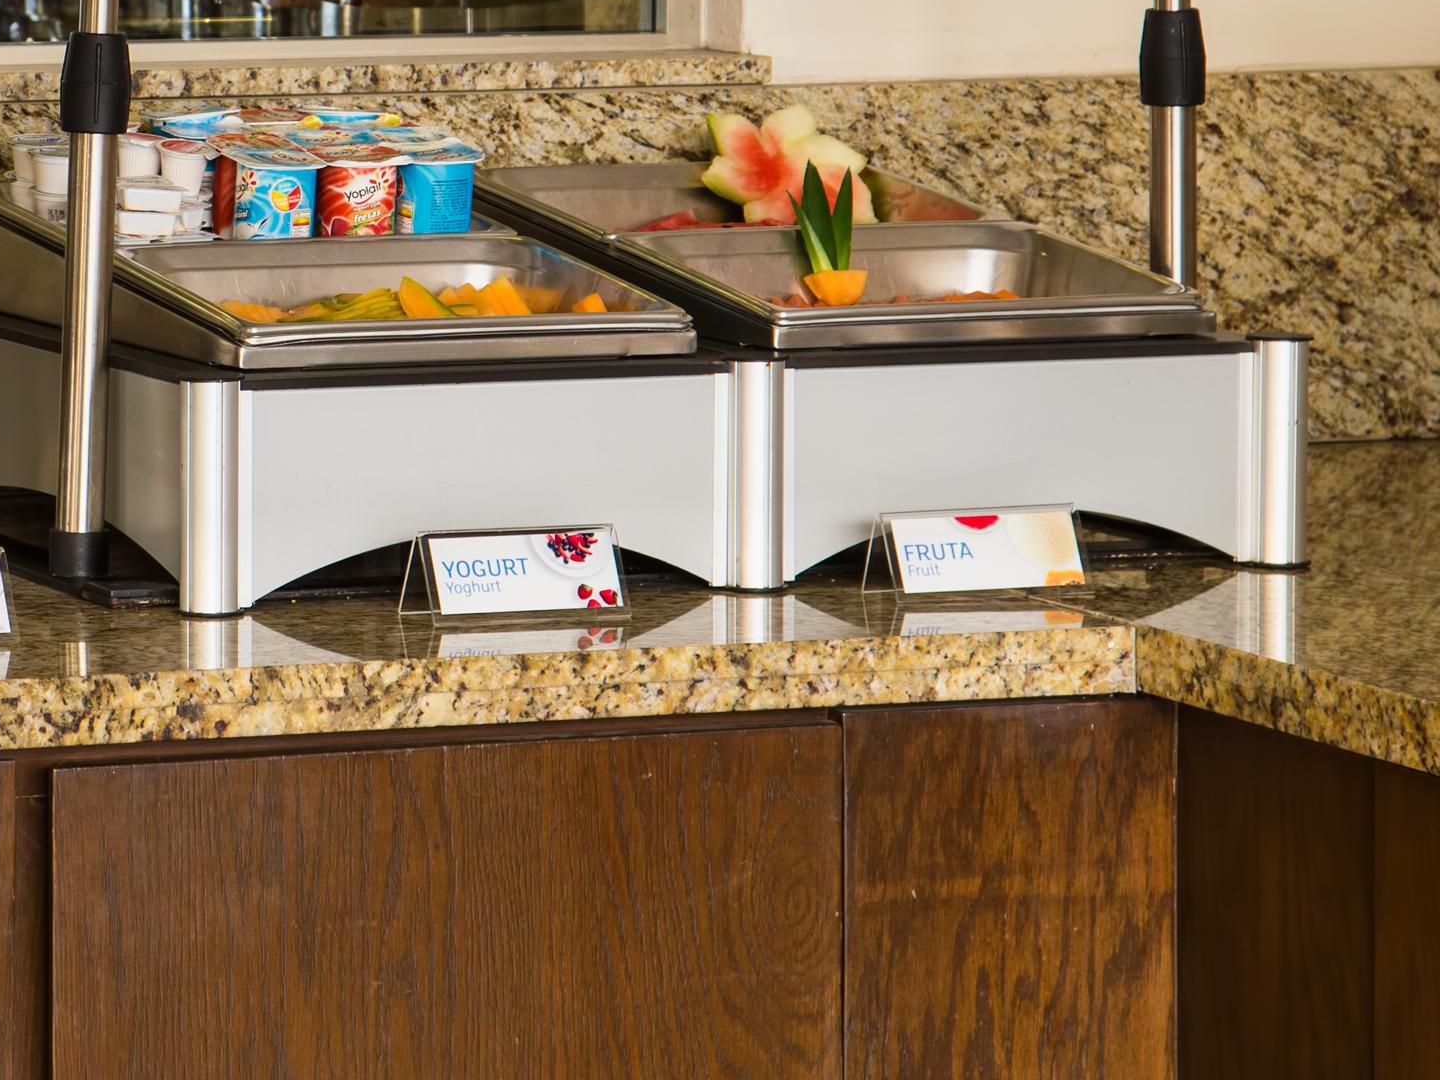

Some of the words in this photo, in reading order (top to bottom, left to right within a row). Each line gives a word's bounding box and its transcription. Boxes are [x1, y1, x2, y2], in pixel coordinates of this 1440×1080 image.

[904, 542, 974, 561] FRUTA
[441, 558, 528, 578] YOGURT
[908, 564, 941, 576] Fruit
[445, 581, 501, 597] Yoghurt
